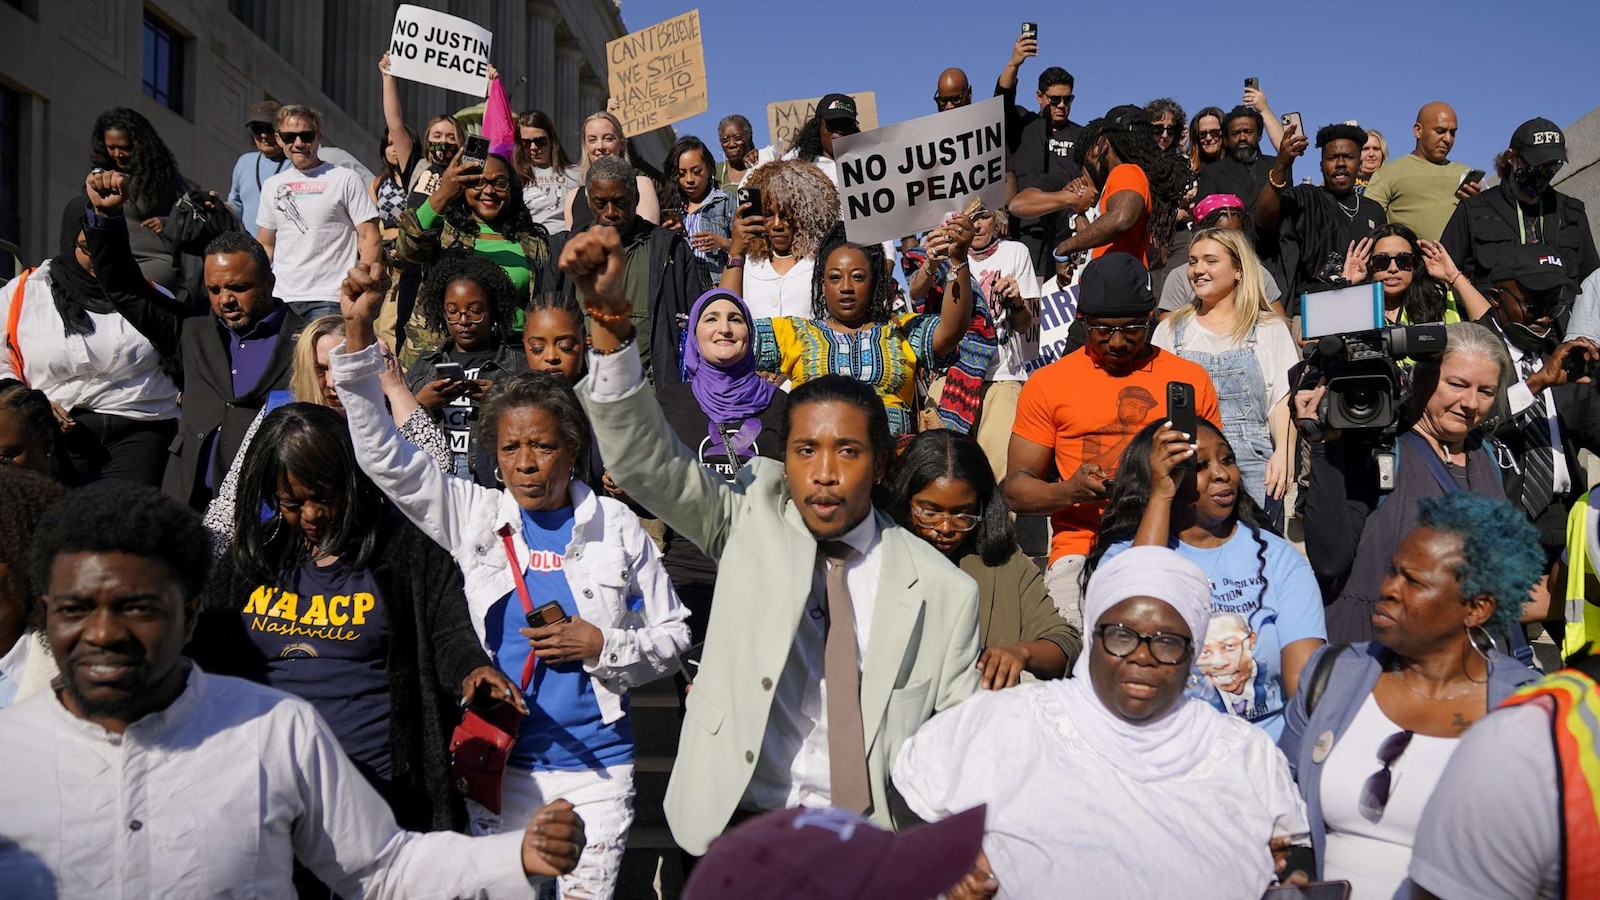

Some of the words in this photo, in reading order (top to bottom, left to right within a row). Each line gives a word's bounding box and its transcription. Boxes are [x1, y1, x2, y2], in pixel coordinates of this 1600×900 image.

[396, 19, 419, 38] NO
[424, 26, 489, 59] JUSTIN
[656, 14, 699, 51] BELIEVE
[391, 40, 417, 59] NO
[424, 48, 488, 78] PEACE
[616, 63, 643, 89] WE
[647, 49, 693, 79] STILL
[616, 80, 660, 107] HAVE
[664, 70, 691, 90] TO
[622, 84, 695, 120] PROTEST
[621, 112, 658, 133] THIS
[841, 153, 887, 188] NO
[897, 122, 1002, 174] JUSTIN
[848, 187, 895, 220] NO
[906, 155, 1002, 207] PEACE
[1538, 255, 1563, 267] FILA
[531, 552, 564, 568] OLU
[243, 585, 376, 626] NAACP
[251, 616, 361, 641] Nashville
